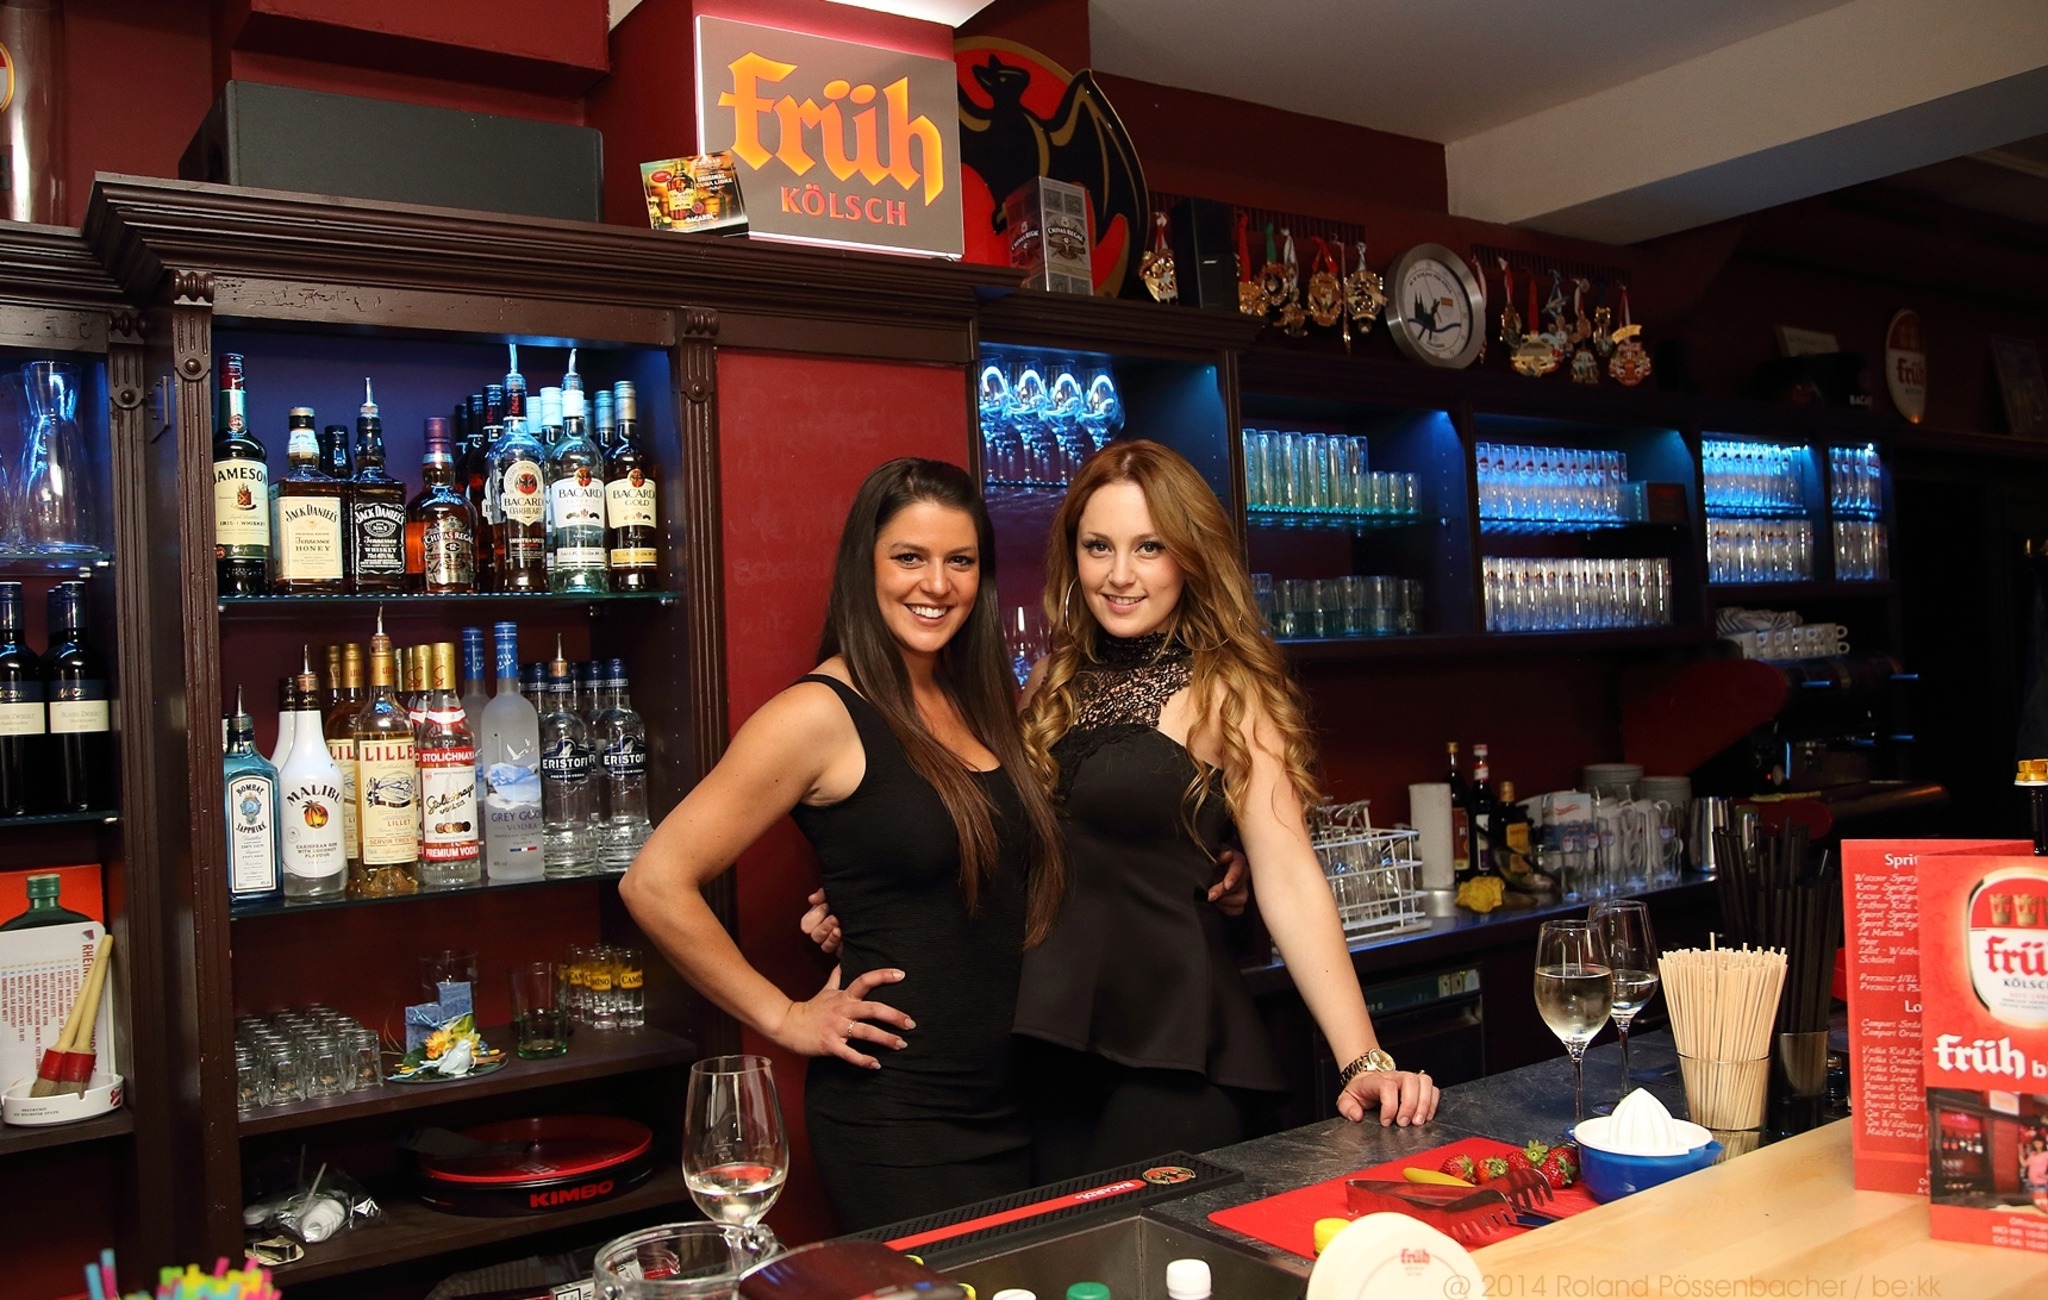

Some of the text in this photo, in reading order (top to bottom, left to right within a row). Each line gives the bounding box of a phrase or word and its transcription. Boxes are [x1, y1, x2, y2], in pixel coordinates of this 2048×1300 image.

[780, 184, 908, 226] KÖLSCH
[285, 505, 306, 522] JACK
[355, 507, 376, 524] JACK
[236, 783, 265, 796] BOMBAY
[286, 784, 342, 807] MALIBU
[491, 812, 515, 822] GREY
[235, 821, 267, 834] SAPPHIRE
[425, 846, 459, 858] PREMIUM
[530, 1180, 614, 1209] KIMBO
